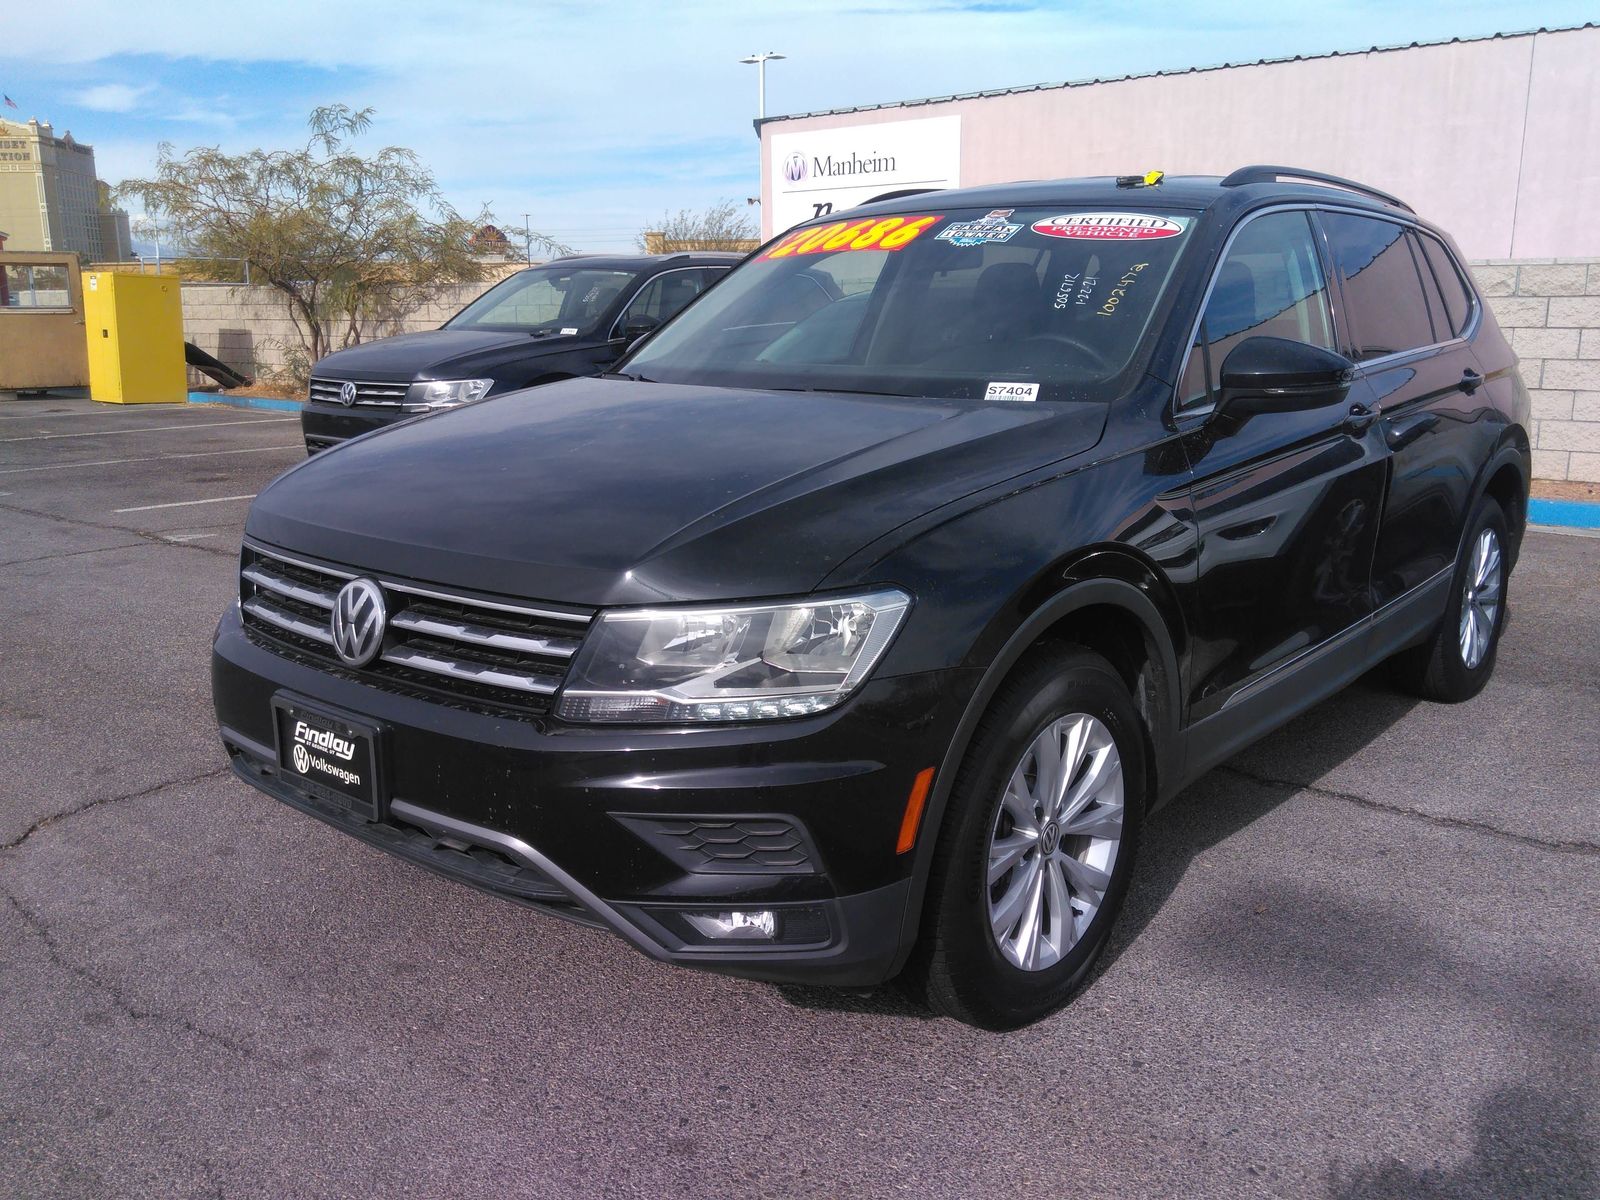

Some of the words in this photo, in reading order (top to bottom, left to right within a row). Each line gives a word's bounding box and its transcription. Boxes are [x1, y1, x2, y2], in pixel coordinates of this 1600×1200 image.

[0, 152, 30, 161] TION
[812, 150, 897, 178] Manheim
[1051, 216, 1168, 228] CERTIFIED
[950, 224, 1015, 233] CARFAX
[1051, 225, 1158, 234] PRE-OWNED
[955, 231, 1009, 240] OWNER
[1064, 230, 1139, 239] VEHICLE
[988, 386, 1033, 397] S7404
[294, 721, 356, 760] Findlay
[309, 754, 361, 786] Volkswagen
